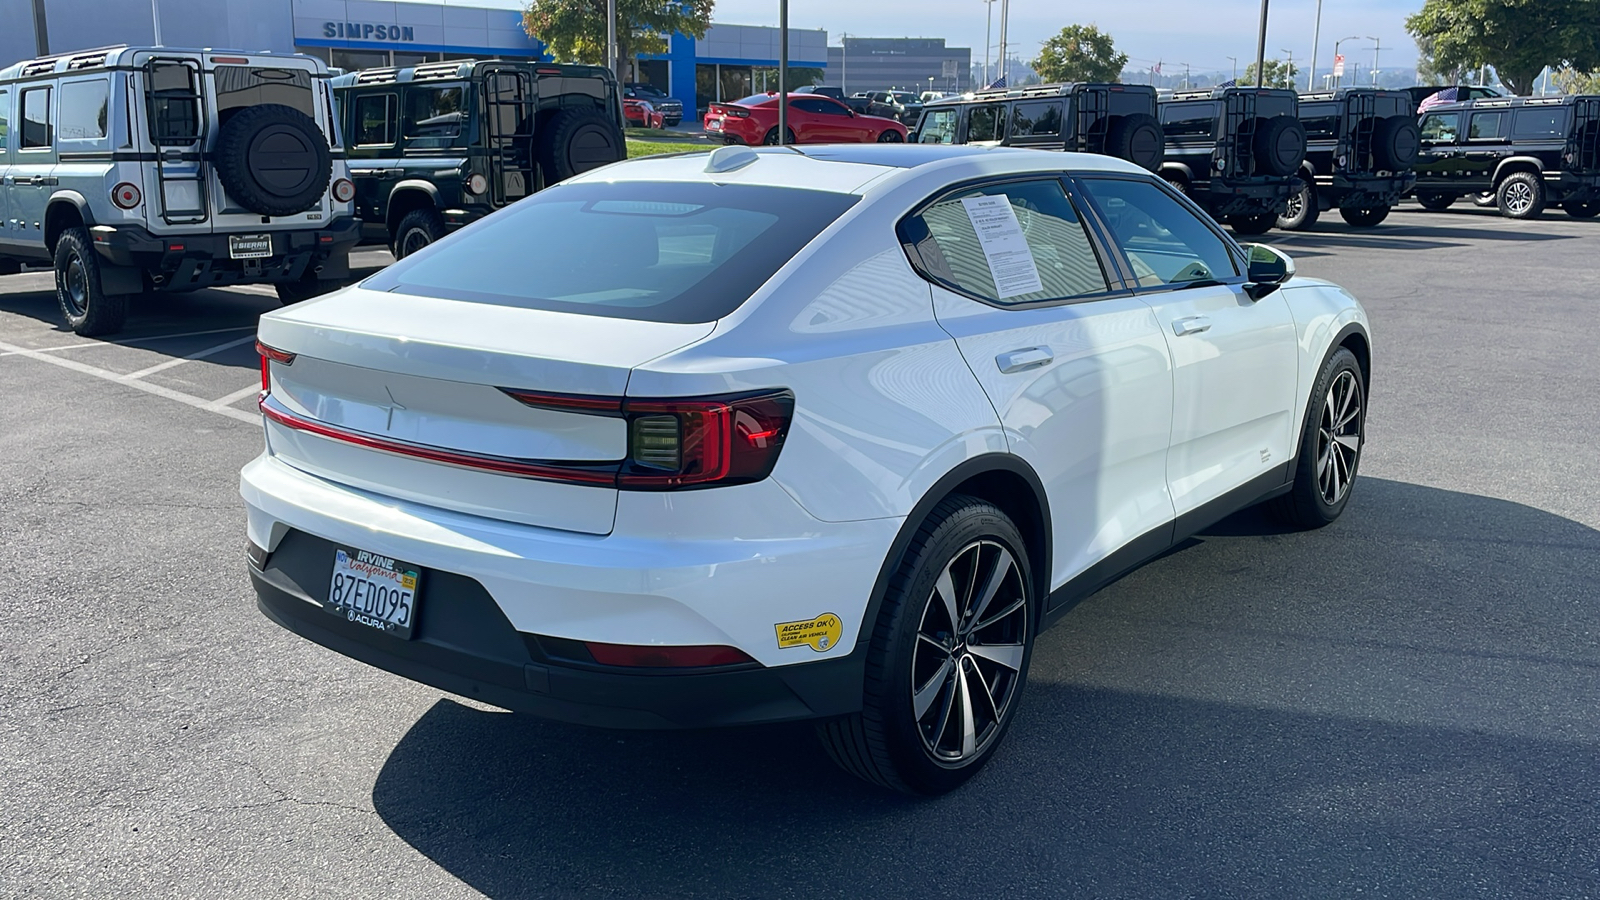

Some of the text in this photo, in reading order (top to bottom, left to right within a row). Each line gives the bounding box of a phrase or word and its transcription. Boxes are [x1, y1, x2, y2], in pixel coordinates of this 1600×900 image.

[323, 22, 414, 41] SIMPSON
[239, 241, 267, 249] SIERRA
[358, 551, 394, 570] IRVINE
[349, 560, 402, 583] California
[332, 572, 411, 625] 8ZED095
[355, 614, 385, 631] ACURA
[782, 620, 829, 632] ACCESS OK
